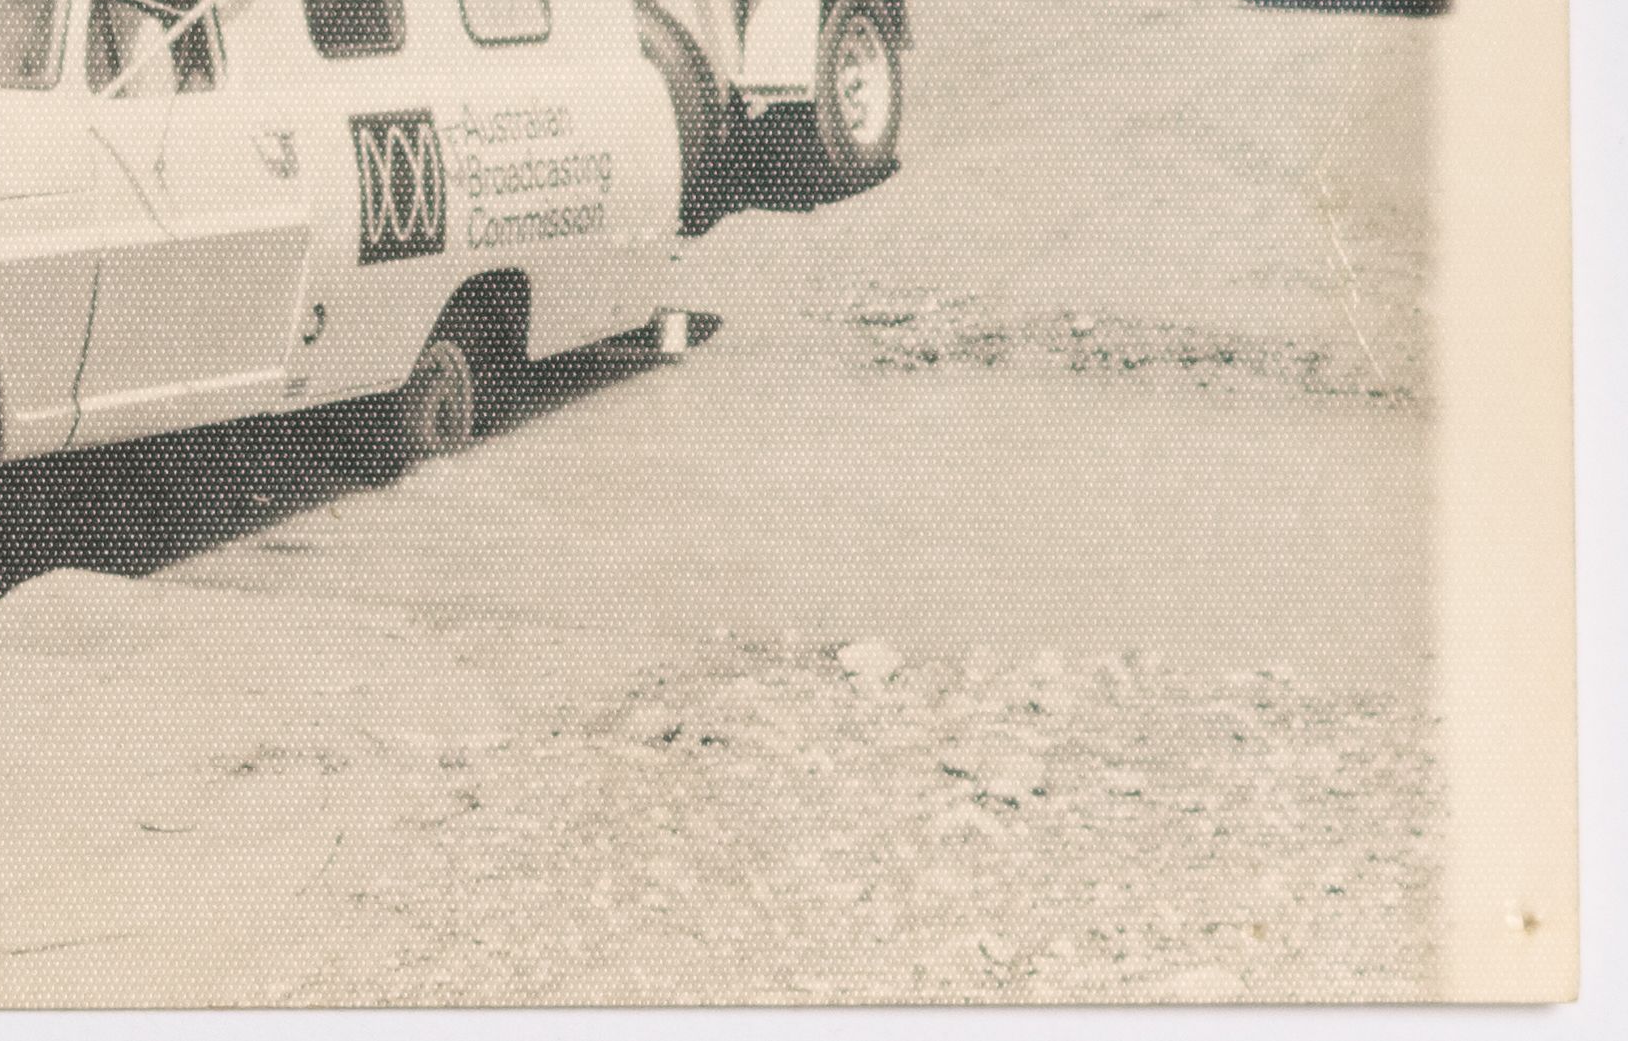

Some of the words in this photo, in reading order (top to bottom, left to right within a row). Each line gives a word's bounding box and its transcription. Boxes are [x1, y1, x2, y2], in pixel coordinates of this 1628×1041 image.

[463, 100, 573, 145] Australian
[466, 149, 612, 198] Broadcasting
[467, 201, 606, 250] Commission
